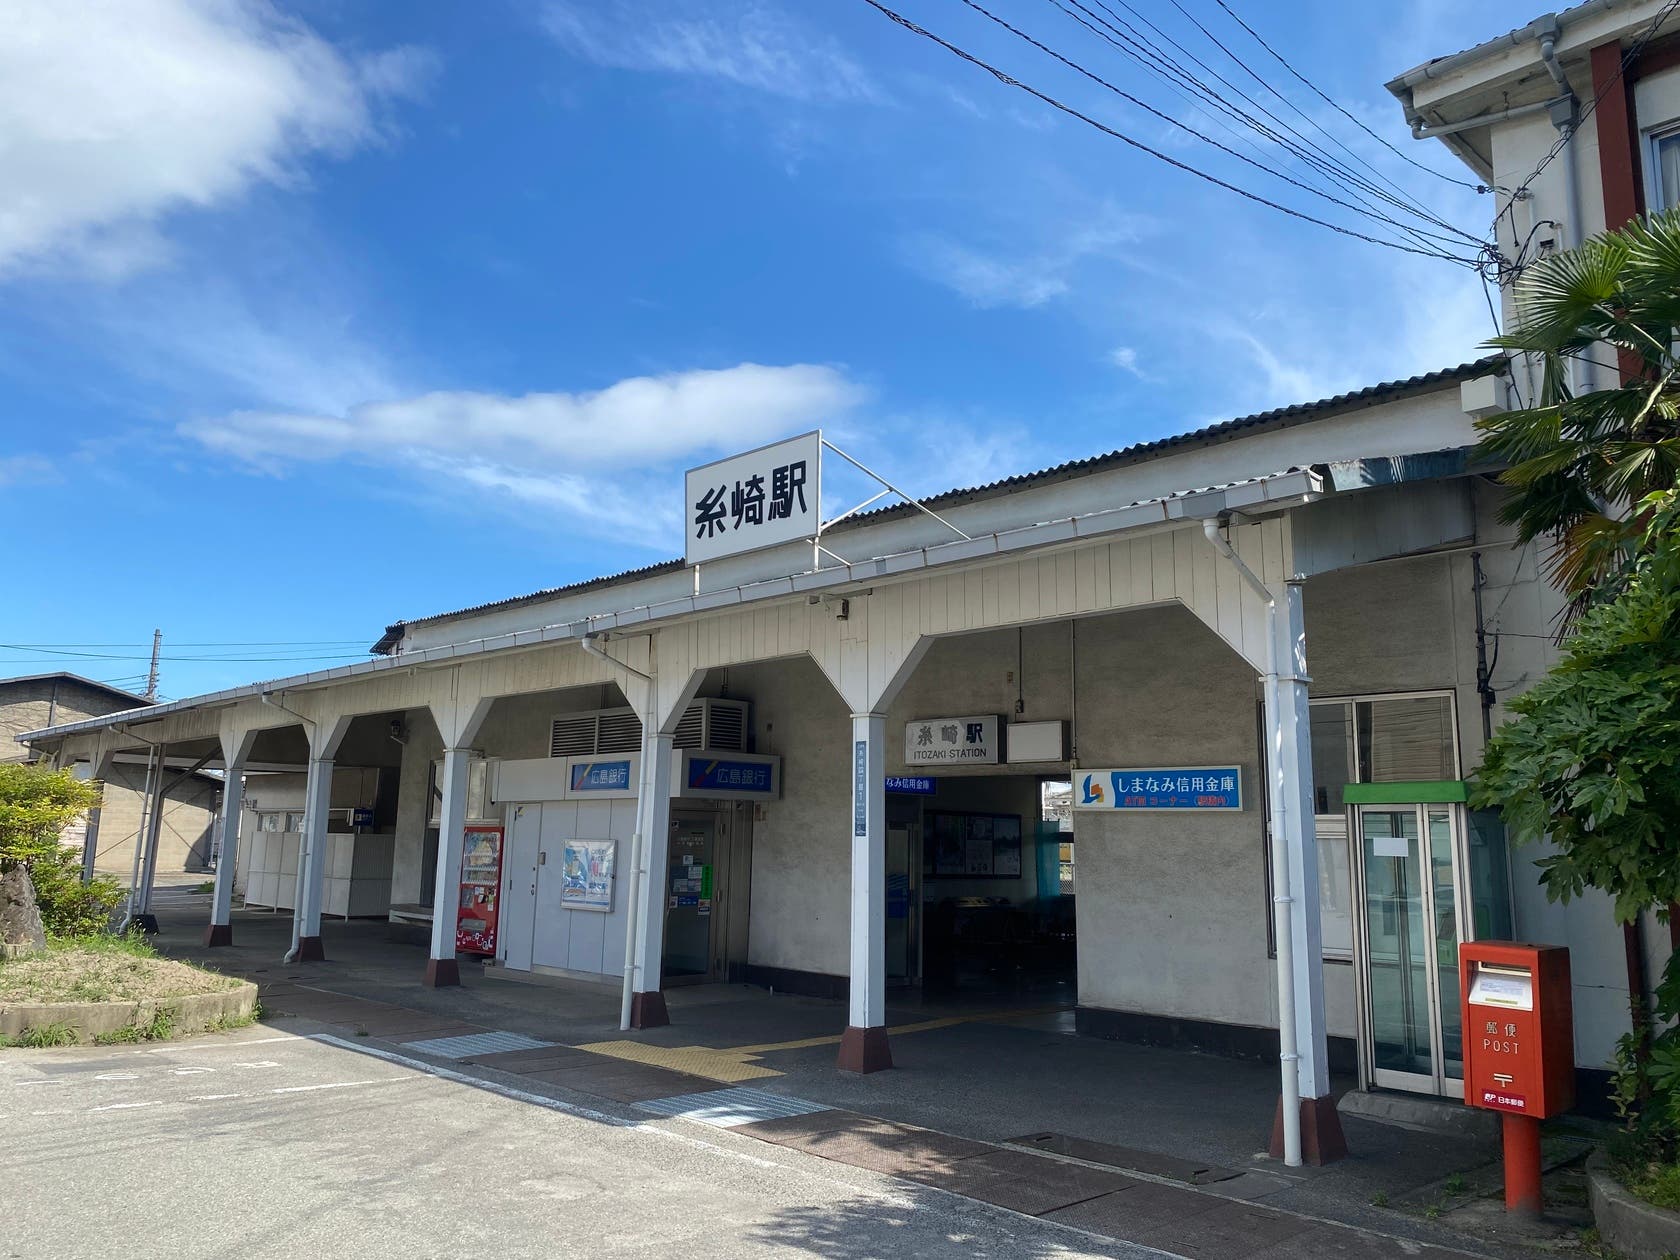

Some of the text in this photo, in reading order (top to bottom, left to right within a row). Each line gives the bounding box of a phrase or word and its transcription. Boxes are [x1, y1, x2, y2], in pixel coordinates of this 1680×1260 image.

[695, 460, 807, 539] 糸崎駅
[917, 723, 983, 746] 糸崎駅
[914, 748, 987, 760] ITOZAKI STATION
[591, 768, 627, 784] 広島銀行
[717, 768, 767, 785] 広島銀行
[1118, 776, 1235, 793] しまなみ信用金庫
[1486, 1021, 1517, 1038] 郵便
[1483, 1038, 1519, 1055] POST
[1498, 1096, 1525, 1108] 日本郵便
